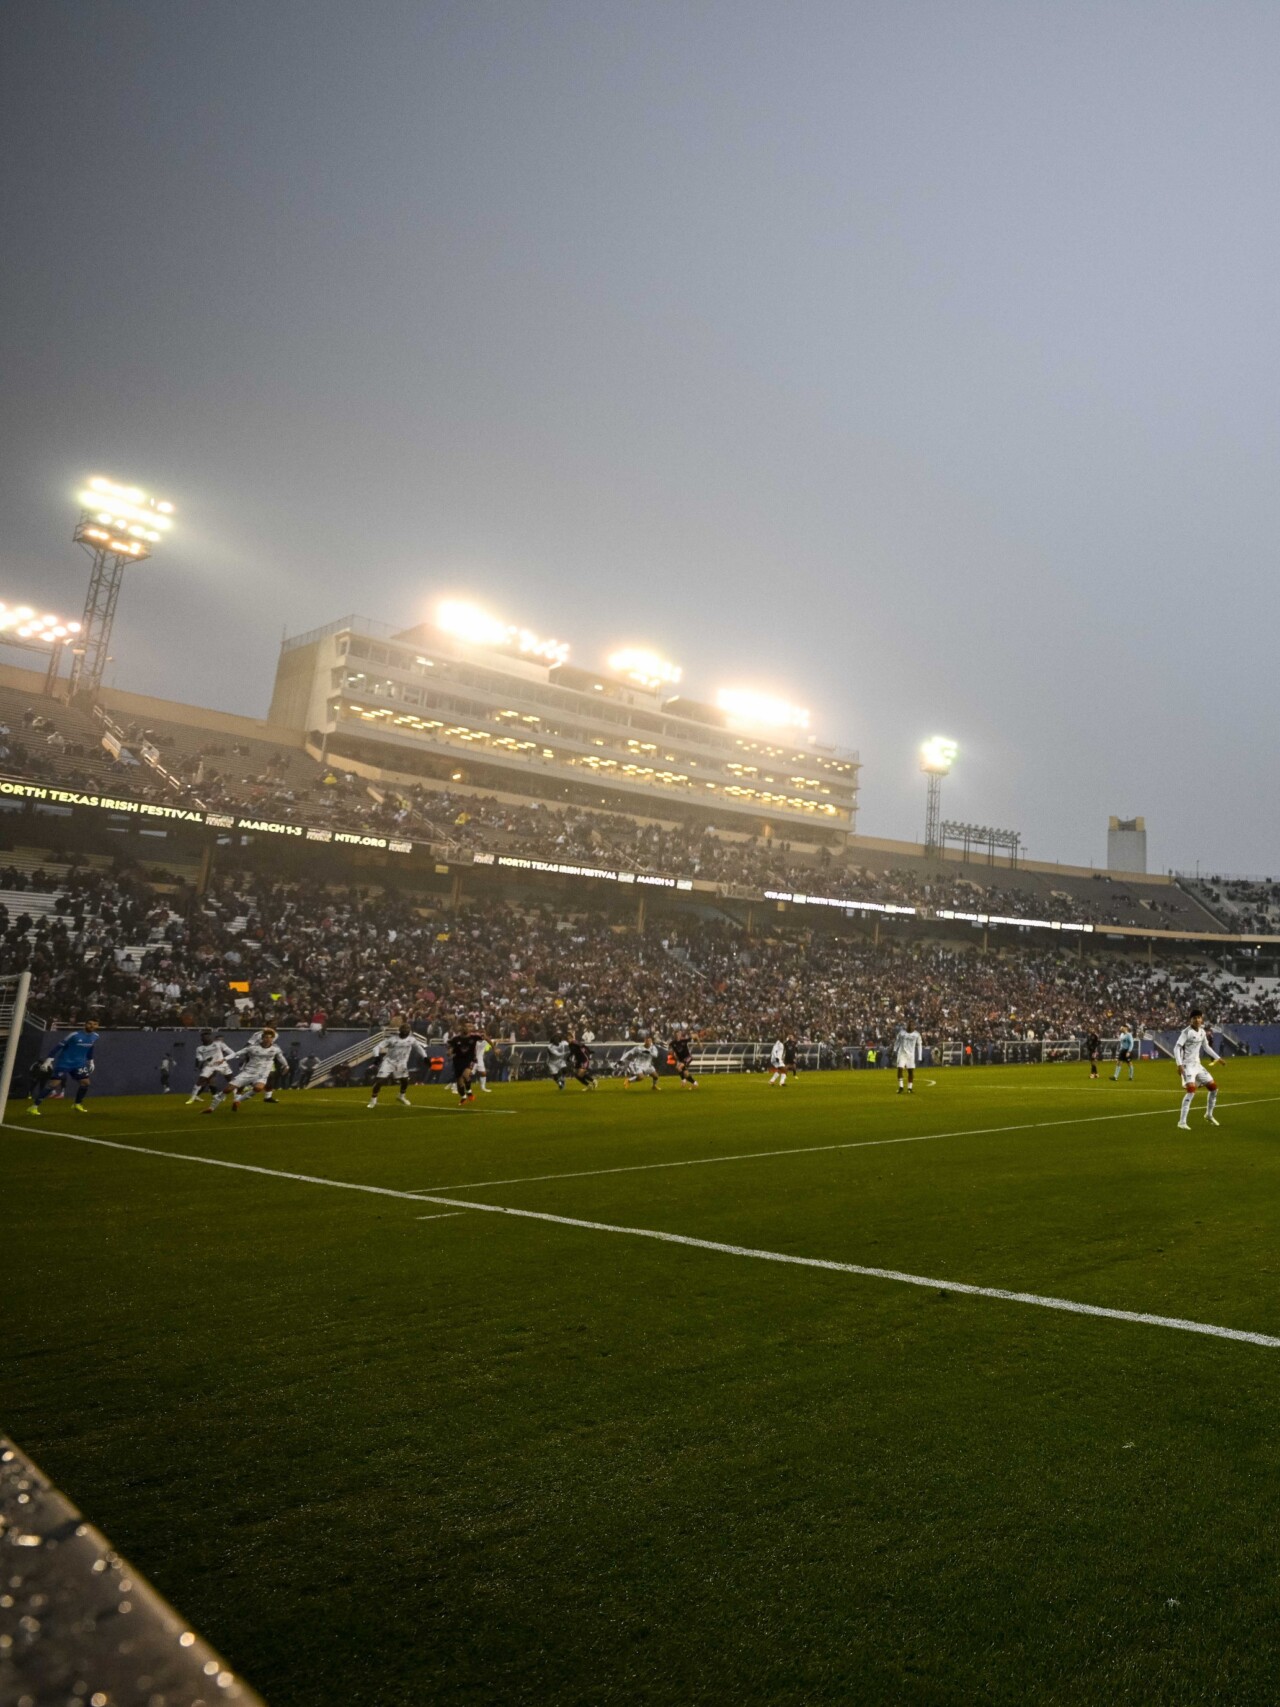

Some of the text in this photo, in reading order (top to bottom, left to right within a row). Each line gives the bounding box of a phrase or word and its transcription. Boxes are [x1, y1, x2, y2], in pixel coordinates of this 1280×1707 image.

[49, 790, 99, 806] TEXAS
[101, 799, 138, 812] IRISH
[140, 804, 203, 822] FESTIVAL
[238, 819, 285, 834] MARCH
[286, 825, 302, 836] 1-3
[334, 833, 387, 848] NTIF.ORG
[498, 857, 531, 869] NORTH
[532, 861, 558, 872] TEXAS
[559, 865, 581, 875] IRISH
[581, 868, 617, 880] FESTIVAL
[637, 875, 664, 886] MARCH
